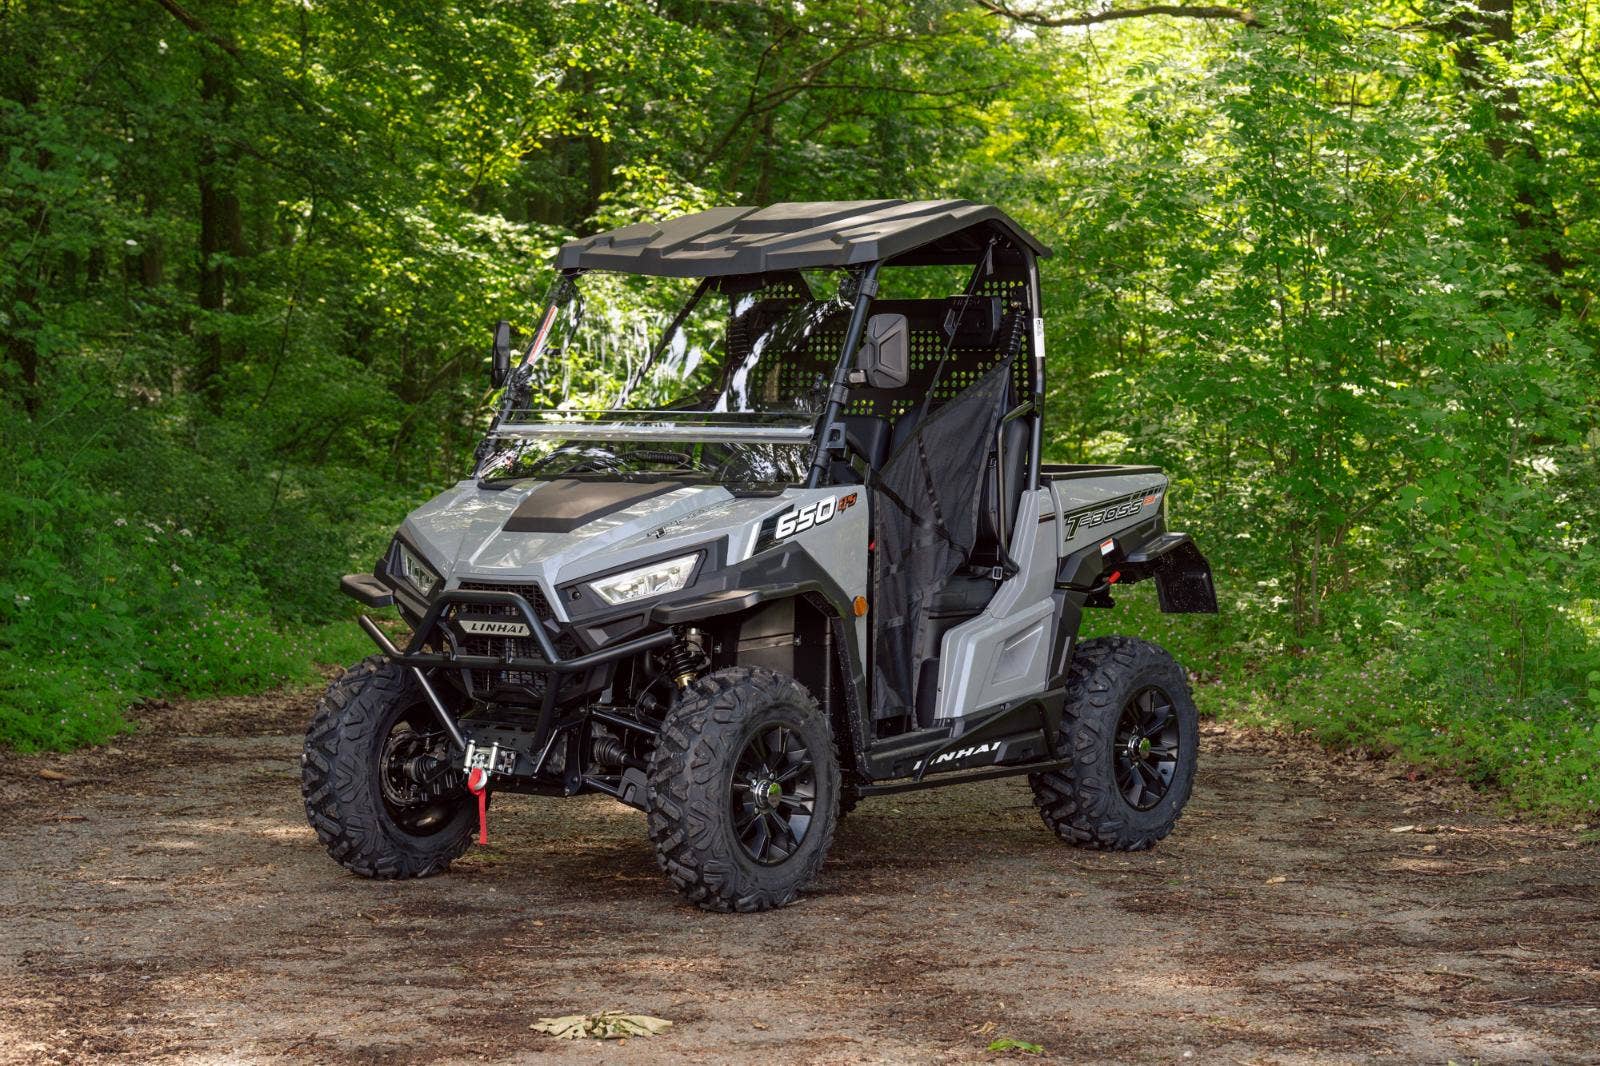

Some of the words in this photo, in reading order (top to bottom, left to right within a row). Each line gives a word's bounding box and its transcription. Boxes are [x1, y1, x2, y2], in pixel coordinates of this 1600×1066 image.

[775, 495, 837, 540] 650
[1065, 499, 1143, 542] T-BOSS
[471, 623, 524, 634] LINHAI
